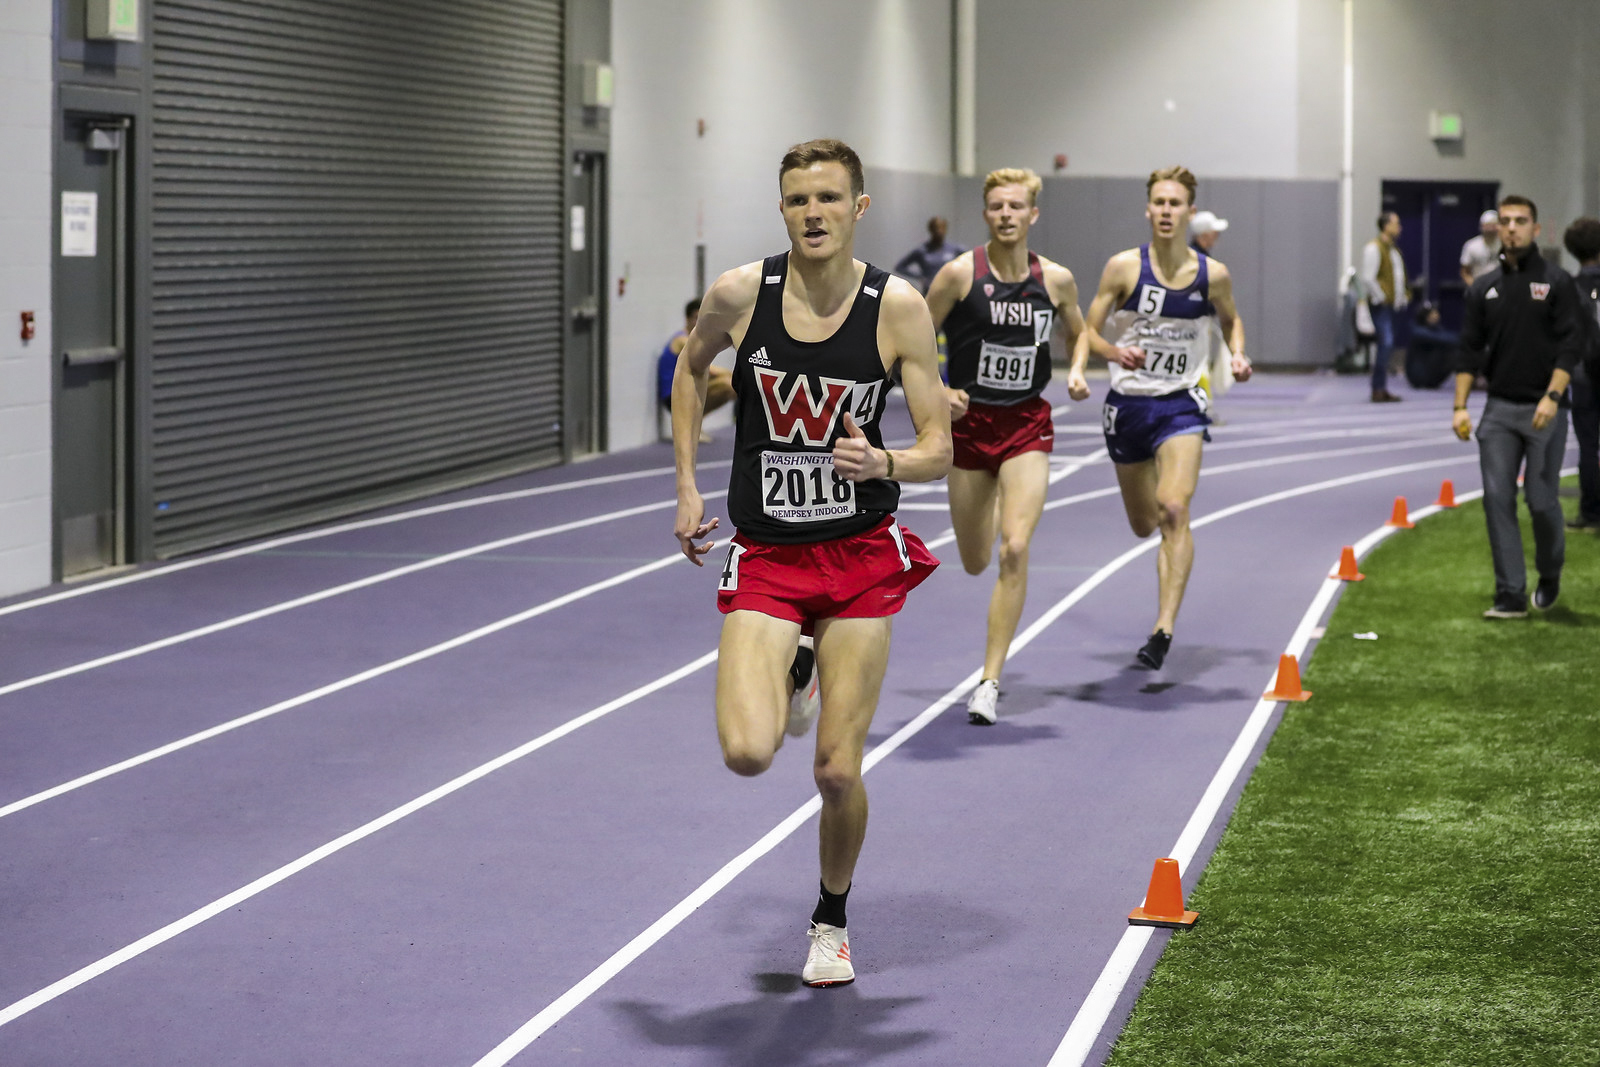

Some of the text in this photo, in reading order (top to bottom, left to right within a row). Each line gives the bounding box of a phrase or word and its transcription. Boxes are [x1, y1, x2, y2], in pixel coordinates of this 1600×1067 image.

[989, 300, 1033, 327] WSU
[1144, 289, 1160, 314] 5
[1039, 312, 1049, 340] 7
[748, 356, 772, 367] adidas
[981, 355, 1032, 382] 1991
[753, 365, 857, 447] W
[854, 384, 876, 423] 4
[766, 454, 836, 466] WASHINGTO
[764, 466, 852, 508] 2018
[771, 505, 850, 519] DEMPSEY INDOOR
